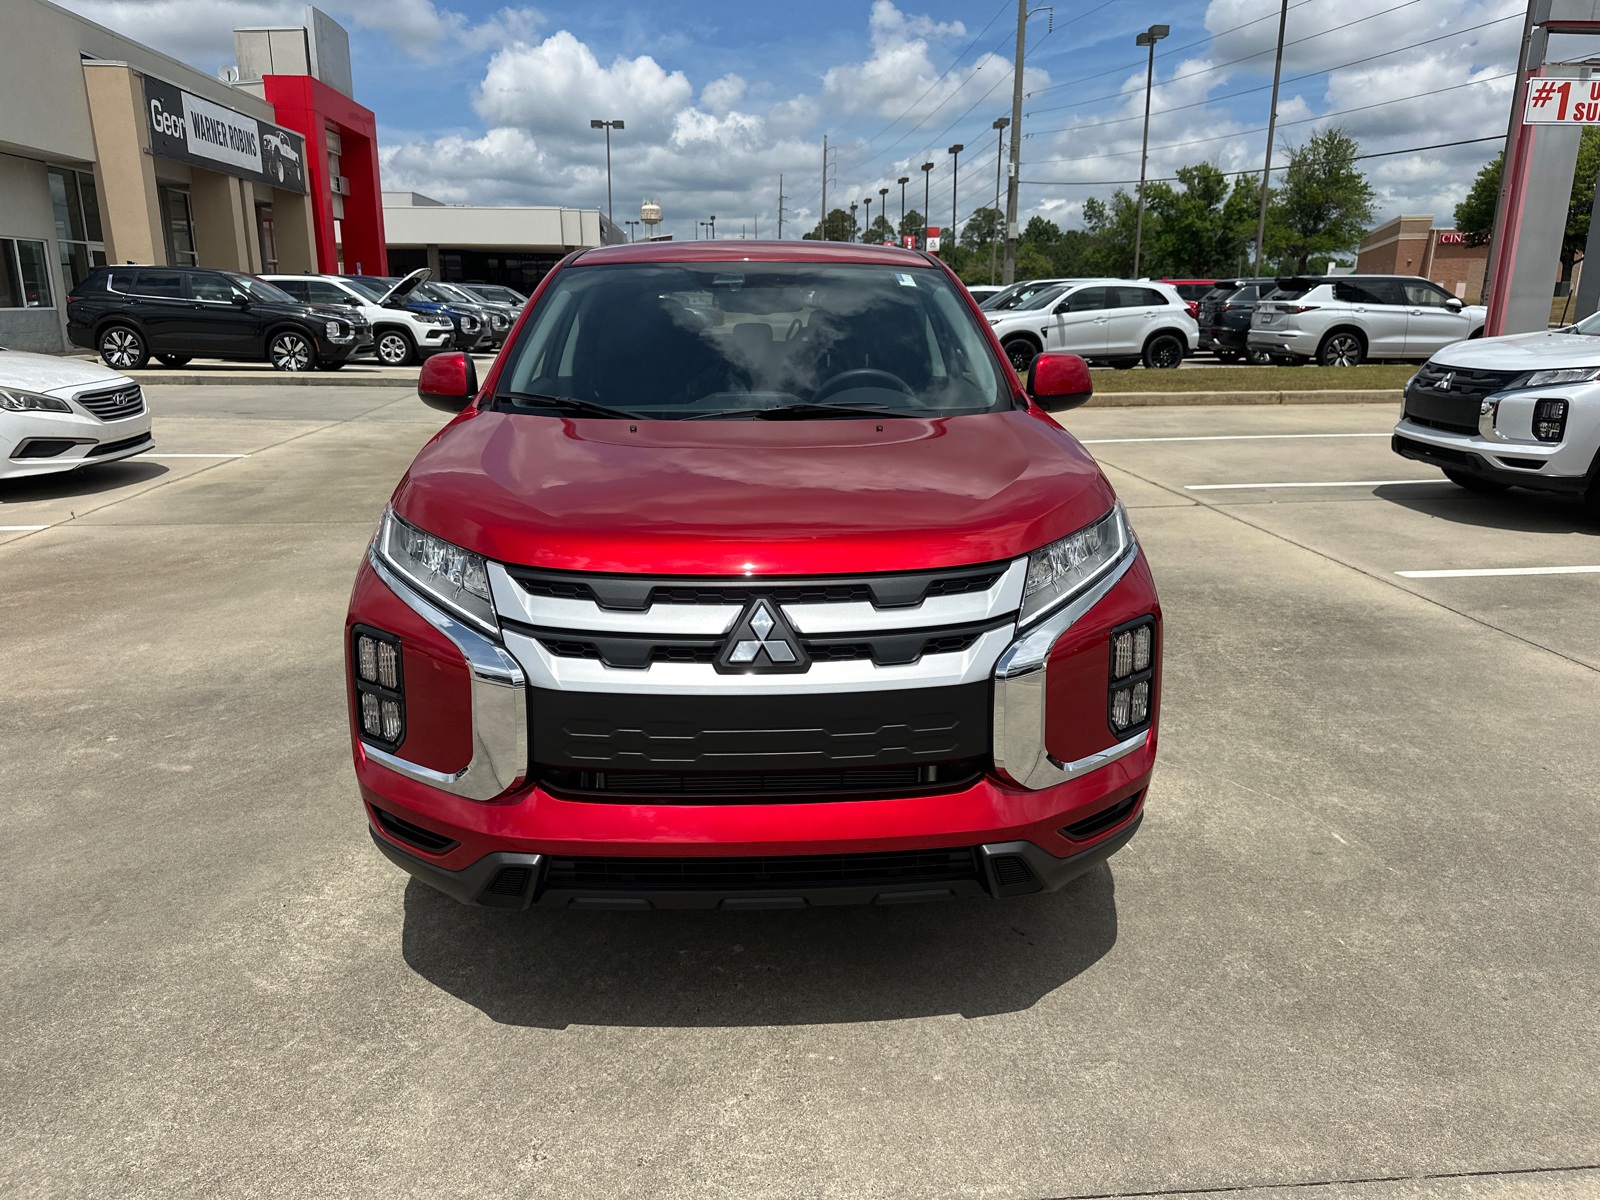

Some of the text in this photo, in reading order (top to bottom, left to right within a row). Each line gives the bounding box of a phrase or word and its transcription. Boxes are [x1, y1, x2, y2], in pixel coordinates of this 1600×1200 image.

[1532, 82, 1571, 120] #1
[1573, 102, 1600, 121] SU
[191, 111, 257, 157] WARNER ROBINS
[1442, 234, 1466, 243] CIN
